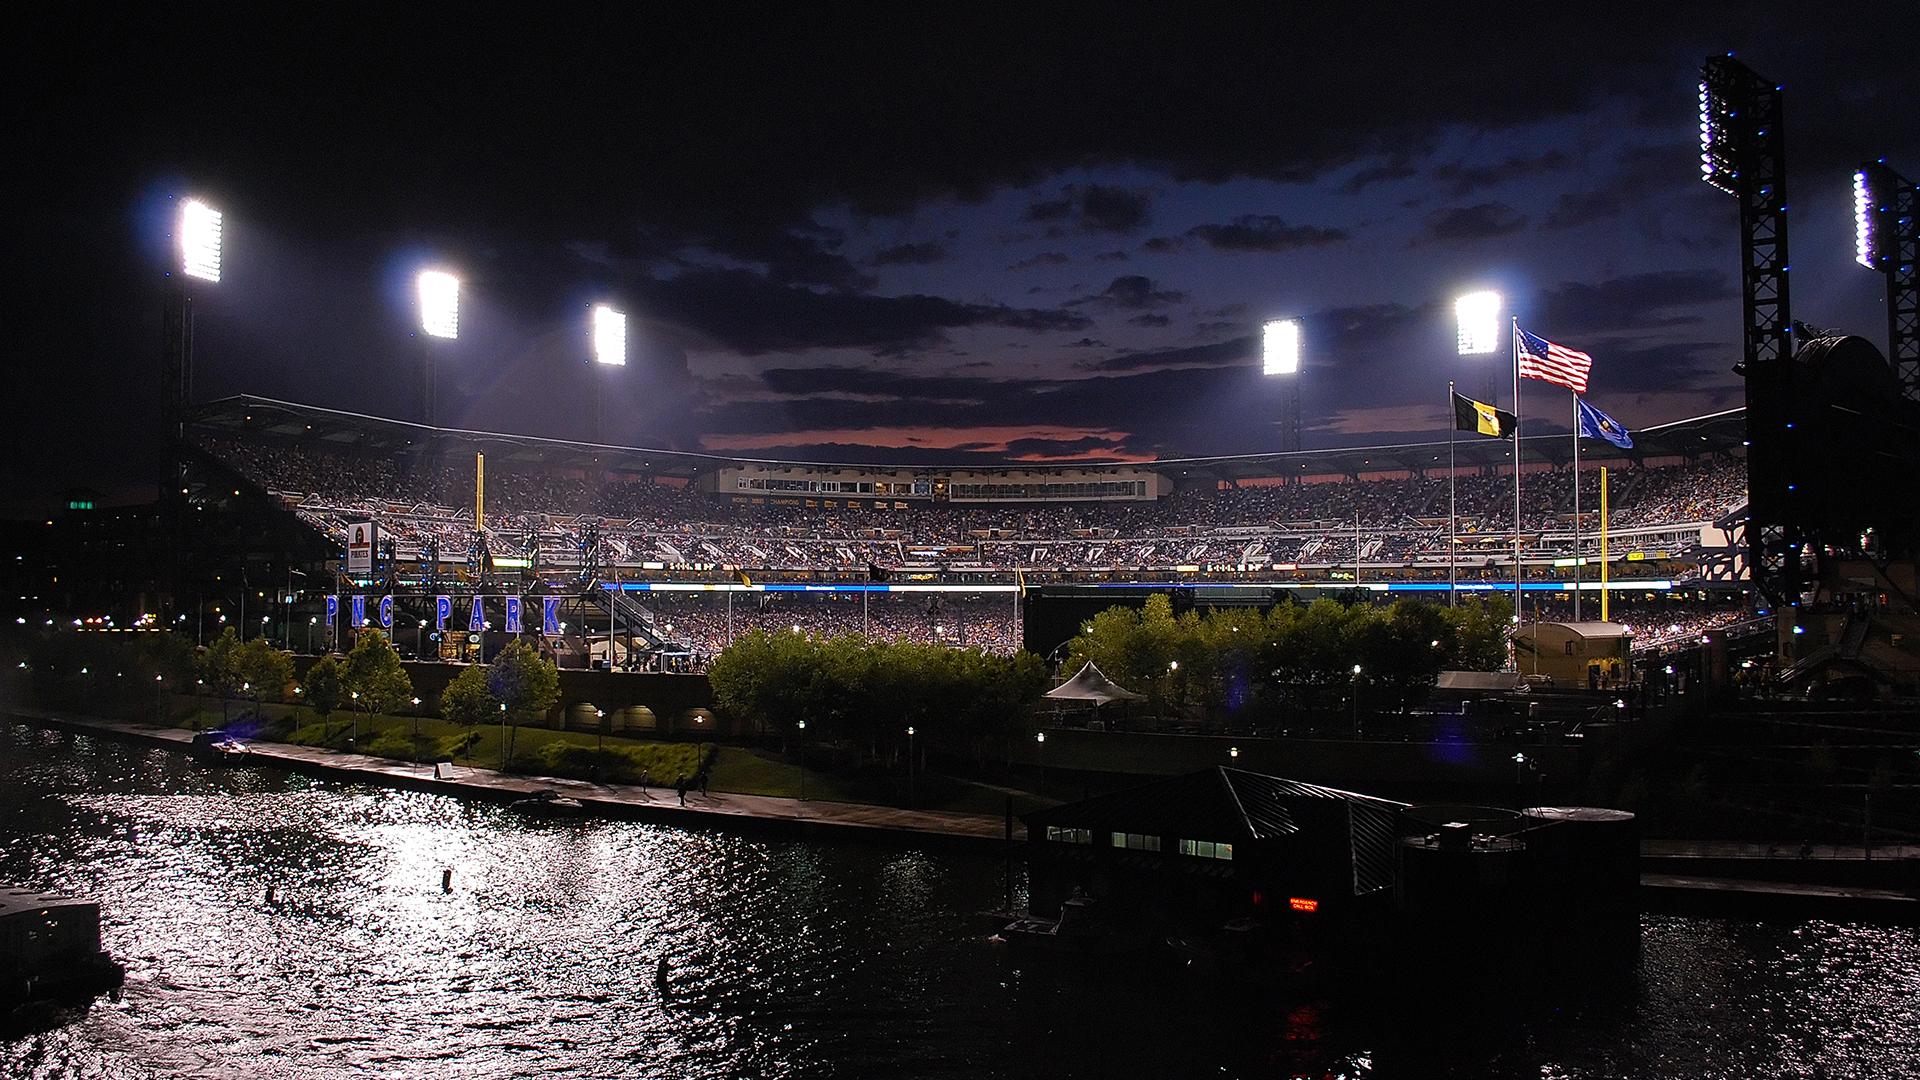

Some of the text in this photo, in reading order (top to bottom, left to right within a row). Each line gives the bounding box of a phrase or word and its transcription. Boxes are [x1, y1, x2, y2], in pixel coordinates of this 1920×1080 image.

[351, 550, 368, 558] PIRATES
[326, 595, 562, 635] PNC PARK
[1290, 898, 1318, 906] EMERGENCY
